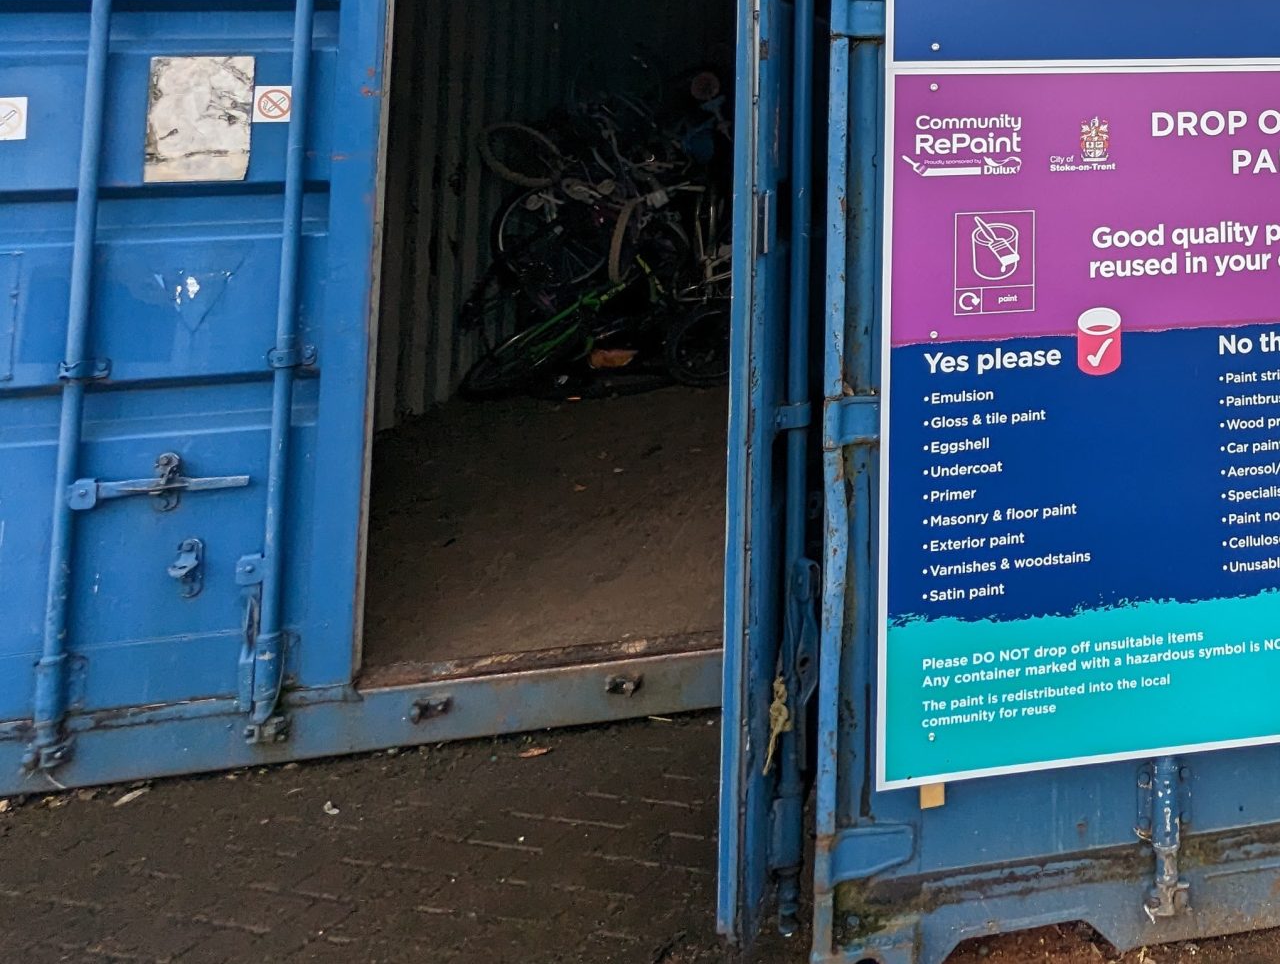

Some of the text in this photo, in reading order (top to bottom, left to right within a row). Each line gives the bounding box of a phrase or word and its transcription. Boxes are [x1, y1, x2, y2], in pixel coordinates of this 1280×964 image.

[916, 114, 1021, 131] Community
[1152, 111, 1247, 136] DROP
[916, 132, 1021, 154] RePaint
[1050, 156, 1065, 164] City
[1050, 163, 1115, 171] Stoke-on-Trent
[984, 165, 1016, 174] Dulux
[1092, 224, 1164, 248] Good
[1172, 221, 1258, 249] quality
[1090, 252, 1177, 278] reused
[1185, 252, 1207, 273] in
[1214, 253, 1271, 276] your
[998, 294, 1017, 304] paint
[1219, 335, 1253, 355] No
[924, 348, 1061, 374] Yes please
[1226, 372, 1257, 383] Paint
[931, 390, 993, 404] Emulsion
[931, 410, 1046, 428] Gloss & tile paint
[1226, 417, 1264, 430] Wood
[931, 437, 989, 454] Eggshell
[1227, 442, 1249, 453] Car
[931, 461, 1002, 477] Undercoat
[931, 489, 976, 502] Primer
[931, 504, 1077, 527] Masonry & floor paint
[1229, 512, 1260, 524] Paint
[930, 533, 1024, 552] Exterior paint
[930, 551, 1091, 576] Varnishes & woodstains
[930, 584, 1004, 601] Satin paint
[923, 632, 1203, 670] Please DO NOT drop off unsuitable items
[923, 676, 949, 687] Any
[954, 668, 1021, 683] container
[1025, 659, 1076, 675] marked
[1081, 657, 1110, 669] with
[1114, 657, 1121, 666] a
[1126, 649, 1194, 665] hazardous
[1199, 642, 1245, 659] symbol
[1250, 641, 1260, 652] is
[923, 674, 1170, 711] The paint is redistributed into the local
[922, 704, 1056, 727] community for reuse
